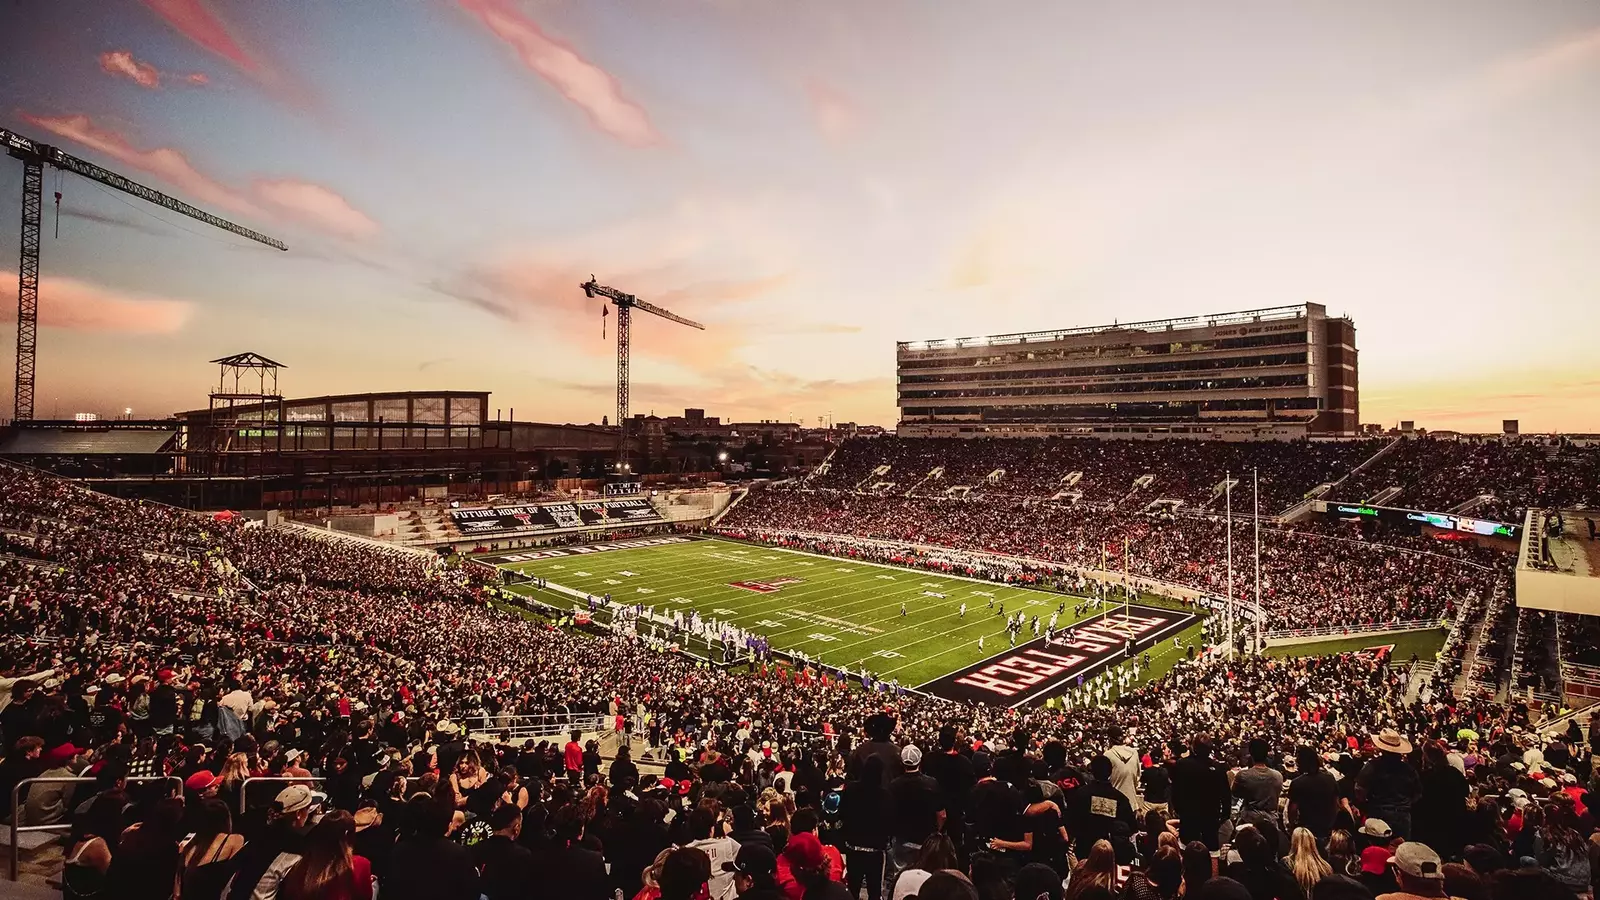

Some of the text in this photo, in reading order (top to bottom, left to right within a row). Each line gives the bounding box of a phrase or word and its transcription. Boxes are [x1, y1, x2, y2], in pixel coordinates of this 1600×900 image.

[1214, 328, 1237, 337] JONES
[1264, 323, 1299, 333] STADIUM
[453, 499, 647, 519] FUTURE HOME OF TEXAS TECH FOOTBALL
[501, 537, 691, 562] RED RAIDERS
[954, 613, 1169, 696] TEXAS TECH
